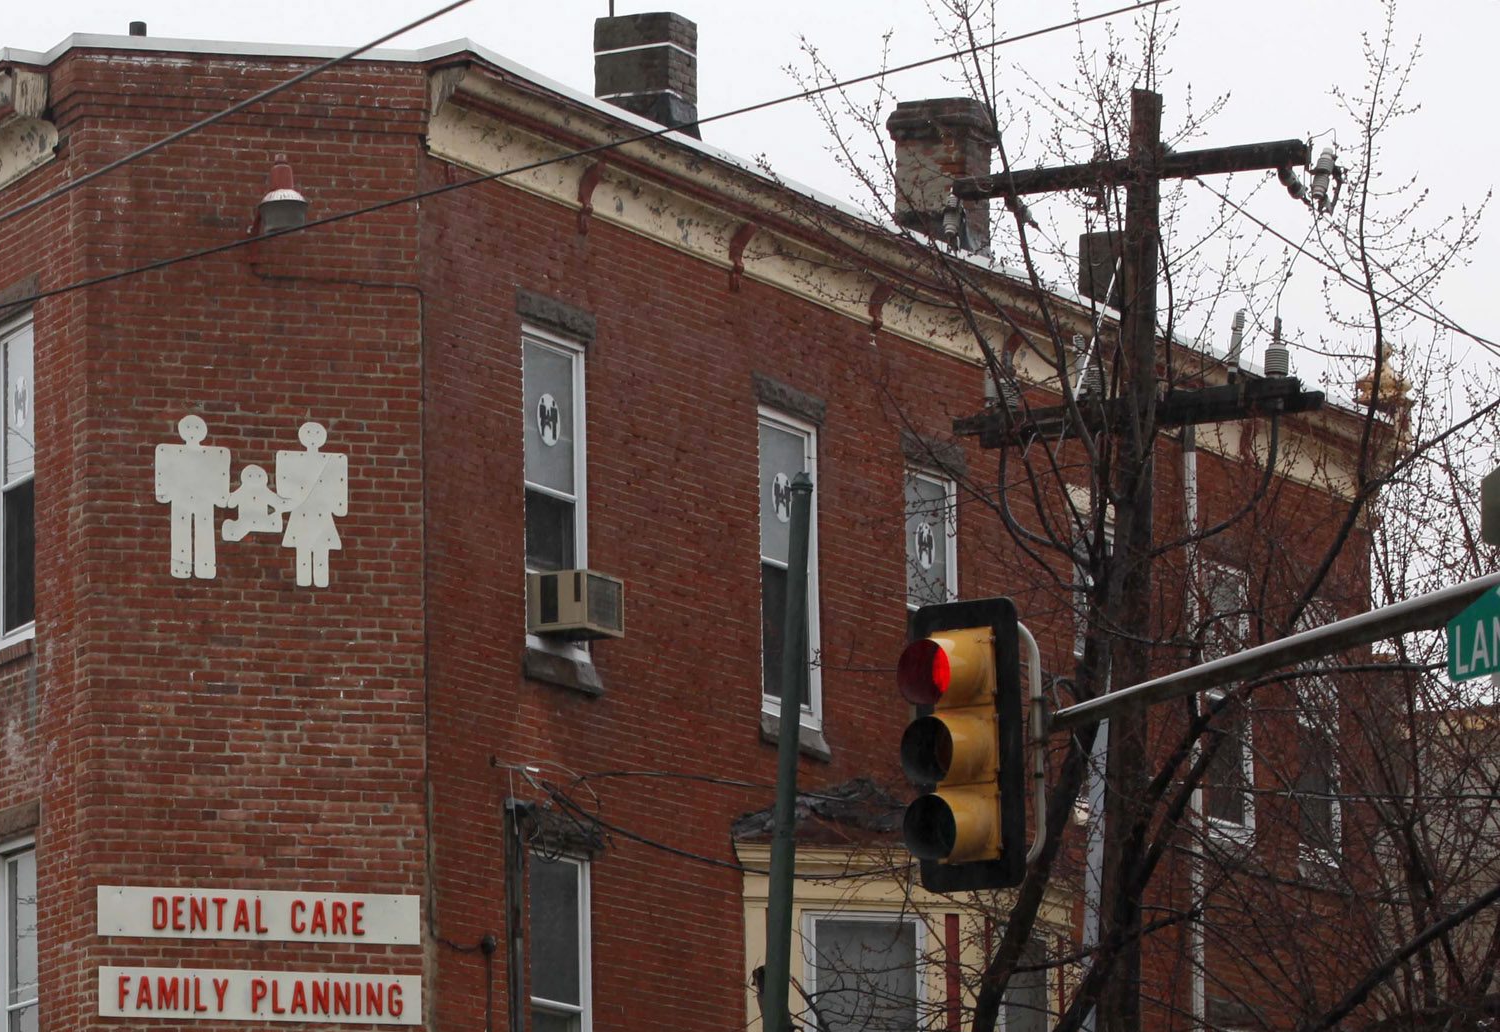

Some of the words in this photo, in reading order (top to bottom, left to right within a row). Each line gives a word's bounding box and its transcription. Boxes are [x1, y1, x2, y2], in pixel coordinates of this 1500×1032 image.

[152, 896, 267, 933] DENTAL
[291, 899, 365, 934] CARE
[118, 975, 228, 1011] FAMILY
[251, 978, 404, 1016] PLANNING
